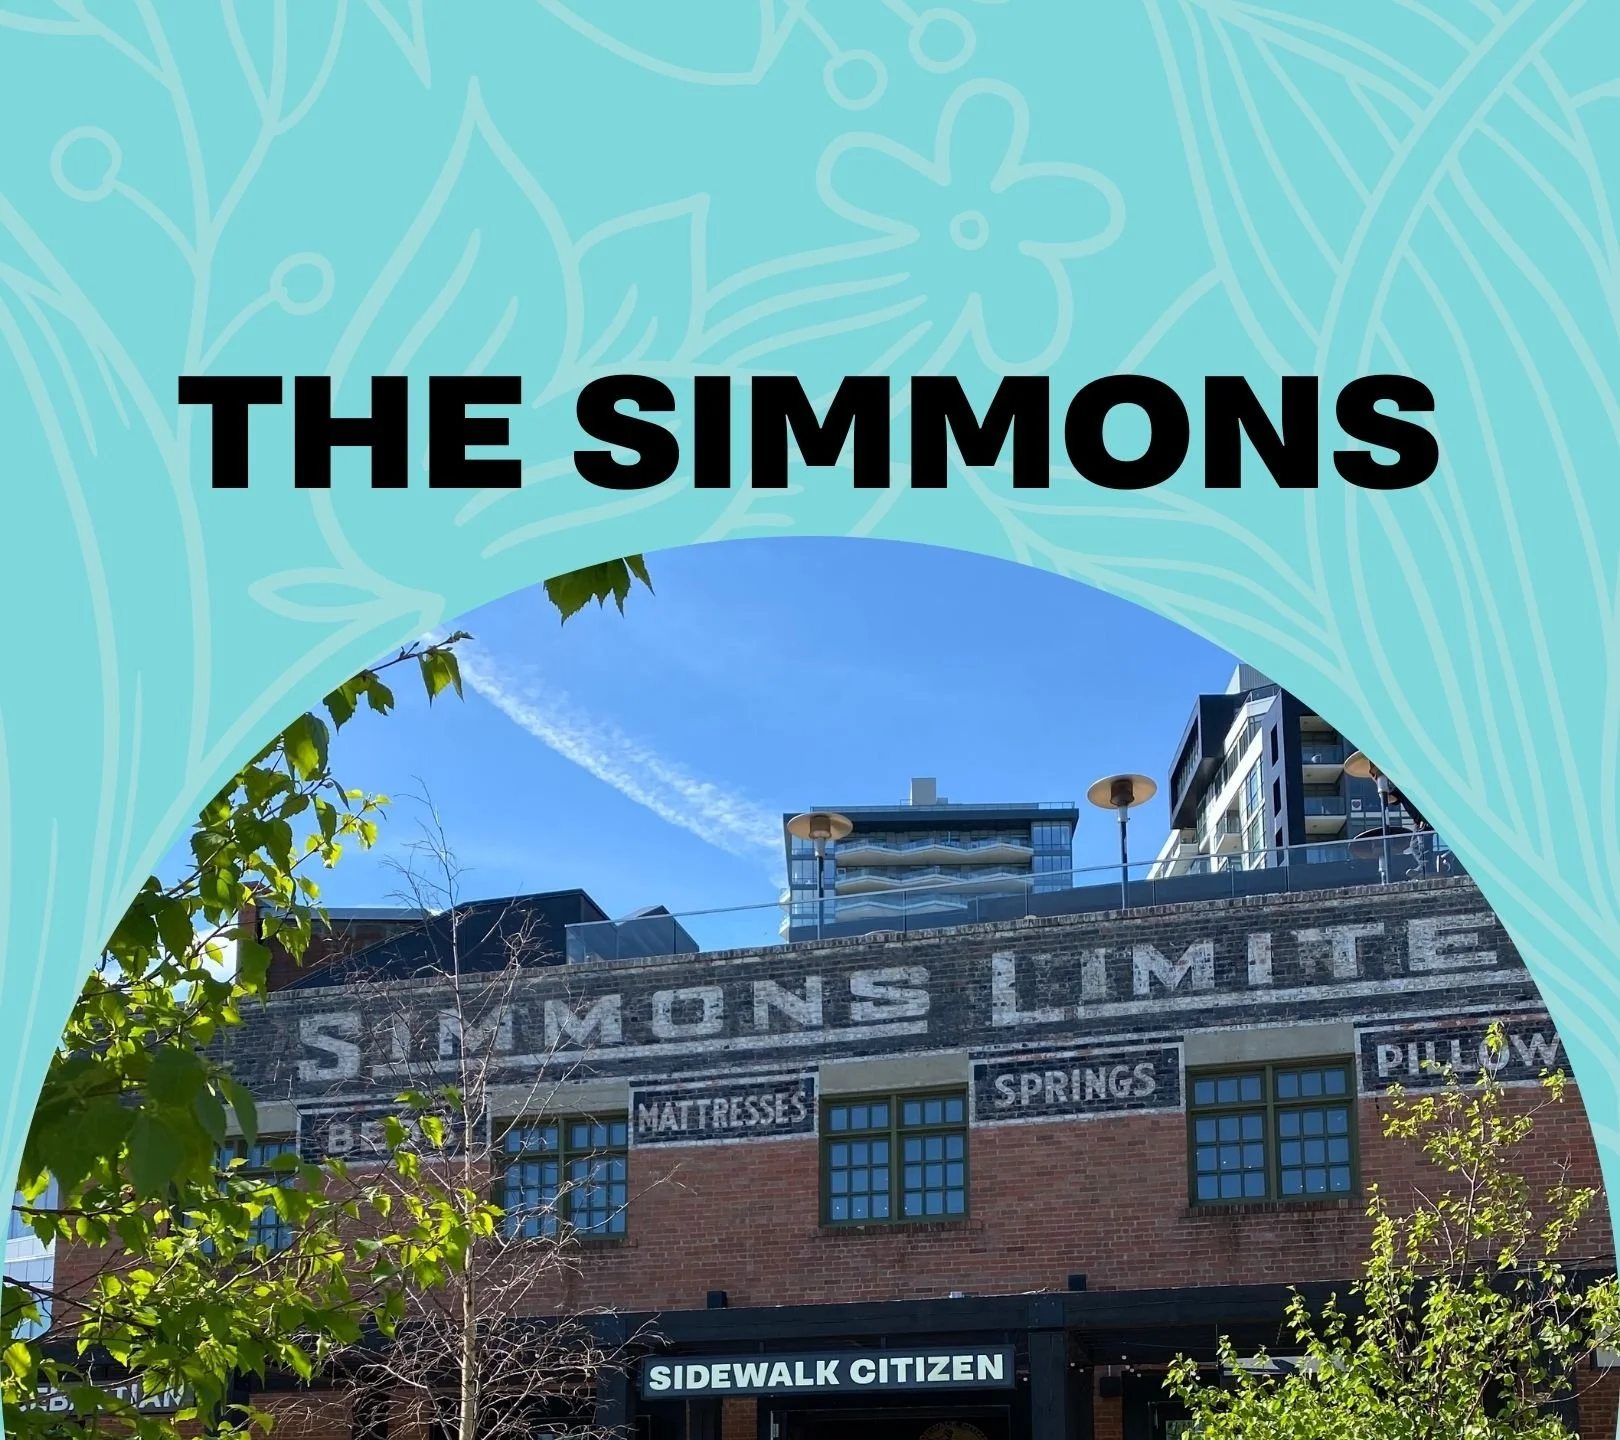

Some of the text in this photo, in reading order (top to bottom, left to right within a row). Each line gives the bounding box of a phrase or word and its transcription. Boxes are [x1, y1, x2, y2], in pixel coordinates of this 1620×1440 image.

[297, 966, 930, 1082] SIMMONS
[994, 1062, 1158, 1108] SPRINGS
[638, 1091, 809, 1134] MATTRESSES
[649, 1353, 1004, 1391] SIDEWALK CITIZEN
